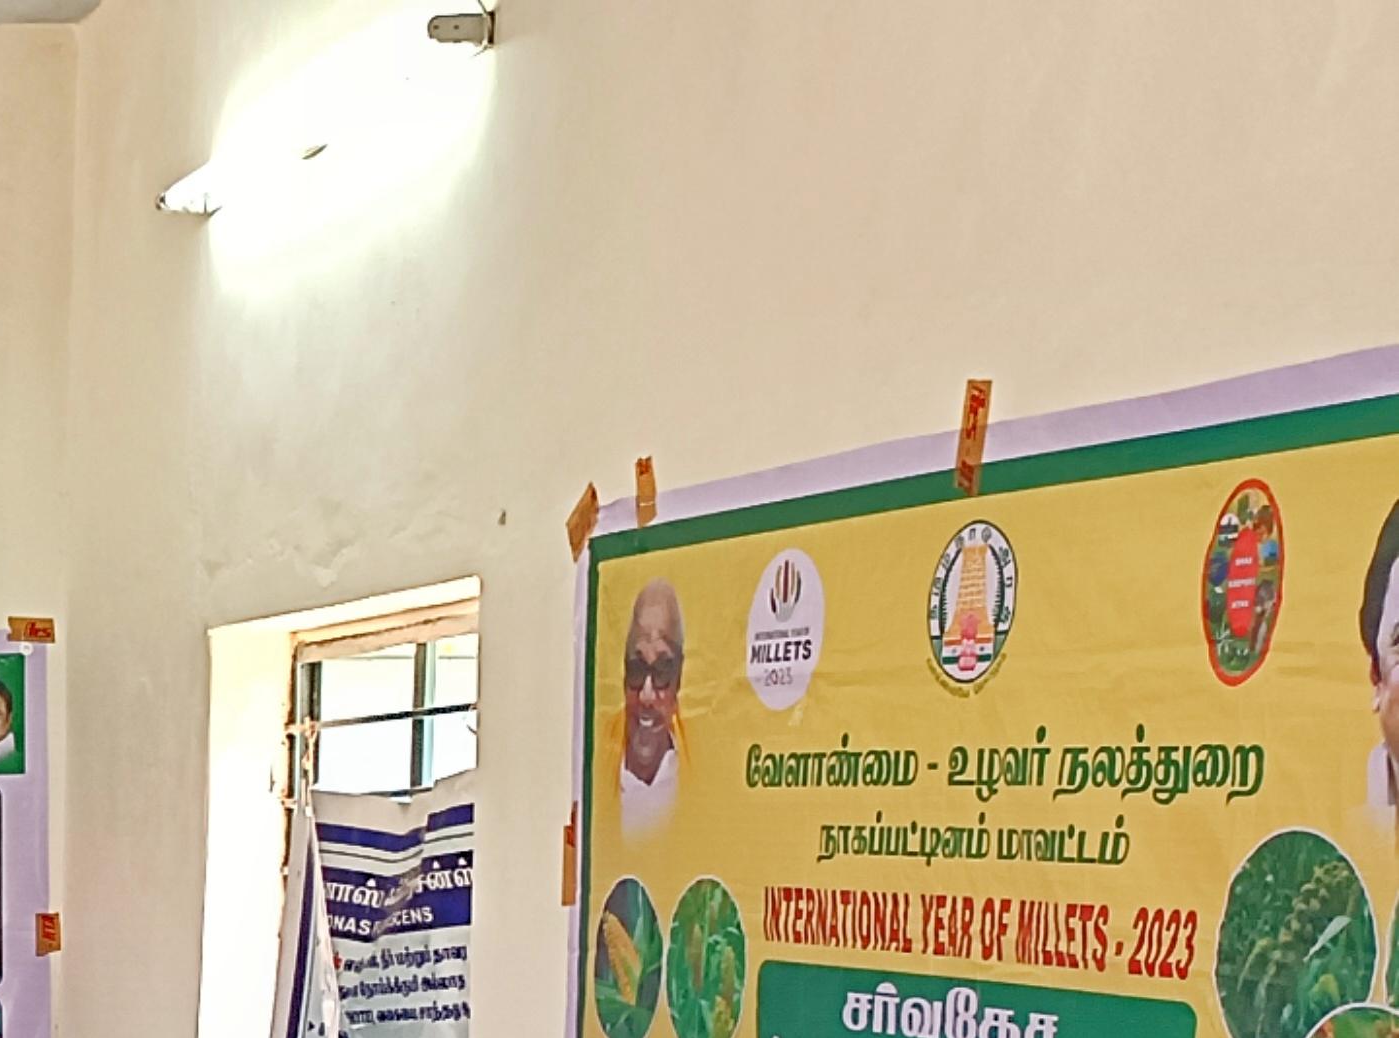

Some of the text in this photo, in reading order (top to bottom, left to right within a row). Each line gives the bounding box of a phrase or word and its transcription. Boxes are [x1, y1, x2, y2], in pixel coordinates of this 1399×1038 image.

[750, 639, 812, 664] MILLETS
[746, 732, 919, 788] வேளாண்மை
[948, 725, 1051, 802] உழவர்
[1053, 723, 1266, 804] நலத்துறை
[816, 811, 1130, 867] நாகப்பட்டினம் மாவட்டம்
[763, 885, 913, 955] INTERNATIONAL
[921, 894, 974, 961] YEAR
[980, 897, 1010, 963] OF
[1015, 899, 1109, 973] MILLETS
[1127, 906, 1199, 981] 2023
